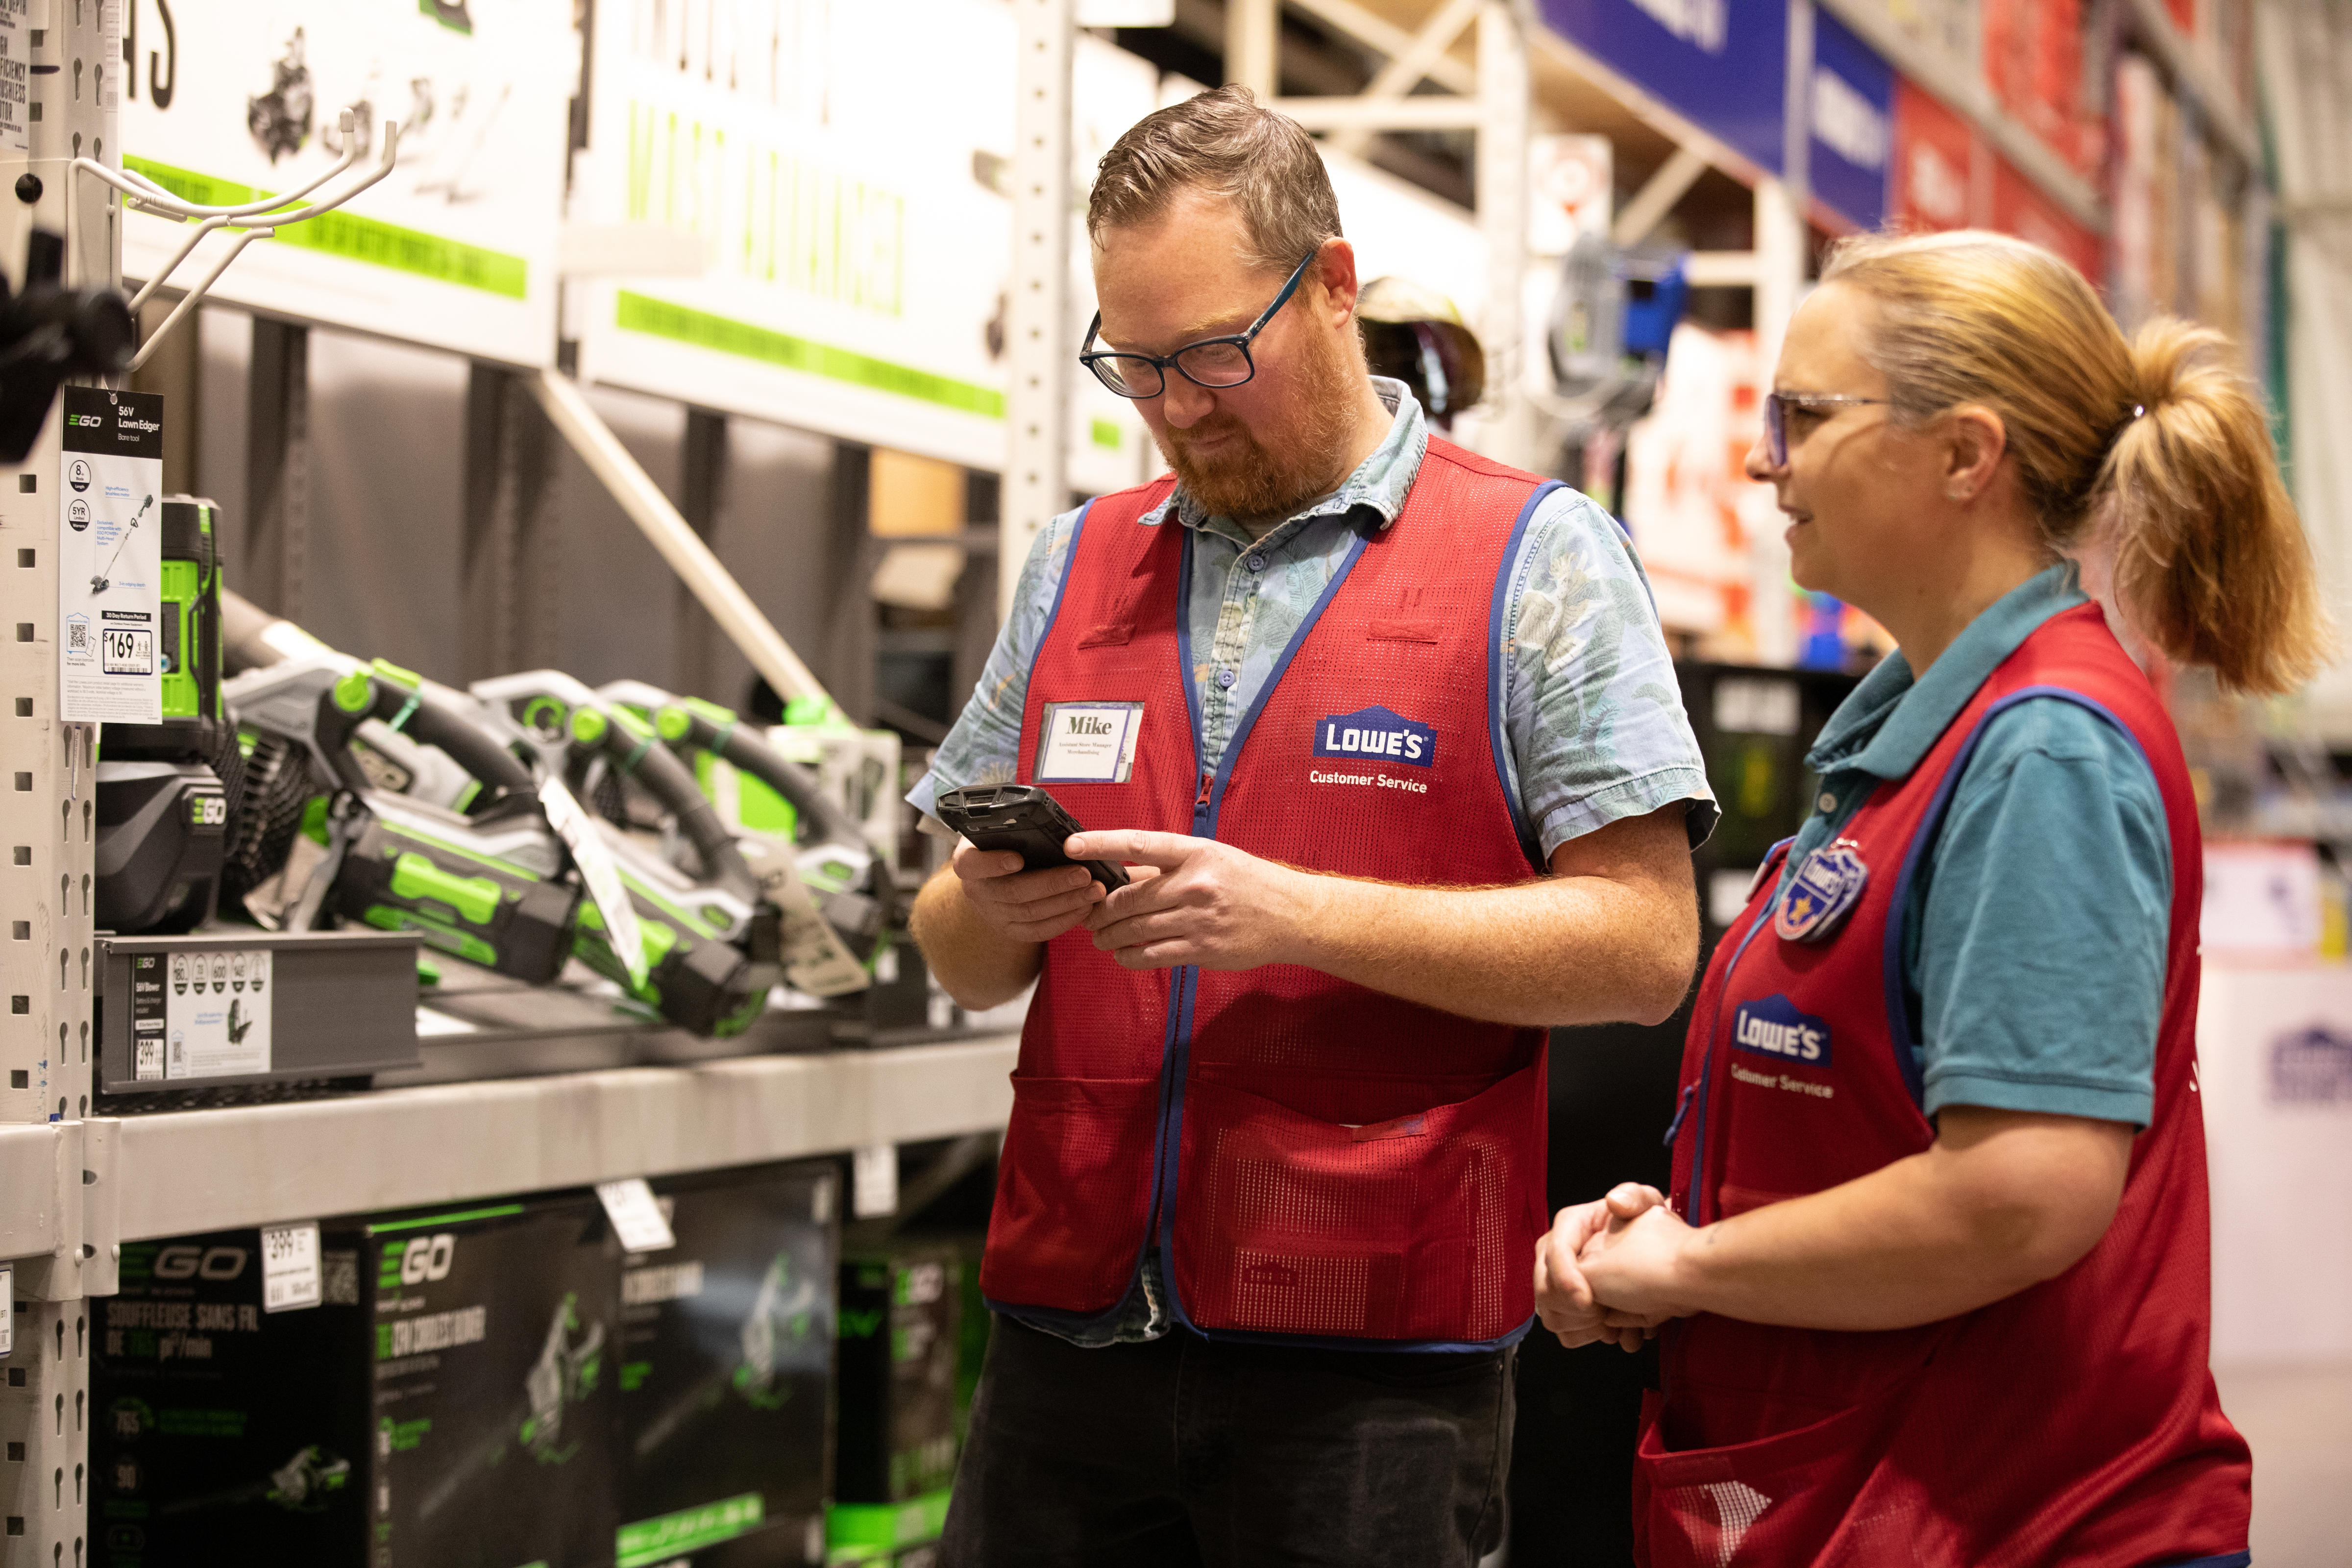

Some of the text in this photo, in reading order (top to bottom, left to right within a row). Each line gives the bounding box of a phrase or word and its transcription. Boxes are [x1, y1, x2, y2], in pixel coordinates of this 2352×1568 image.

[0, 79, 25, 104] USHLESS
[68, 414, 102, 427] EGO
[119, 406, 134, 416] 56V
[119, 418, 160, 433] Lawn Edger
[73, 507, 86, 515] 5YR
[1065, 716, 1112, 735] Mike
[1326, 724, 1423, 759] LOWE'S
[1310, 770, 1427, 793] Customer Service
[193, 797, 227, 824] EGO
[137, 957, 155, 969] EGO
[1737, 1009, 1821, 1060] LOWE'S
[1779, 1074, 1834, 1099] Service
[378, 1233, 455, 1289] EGO
